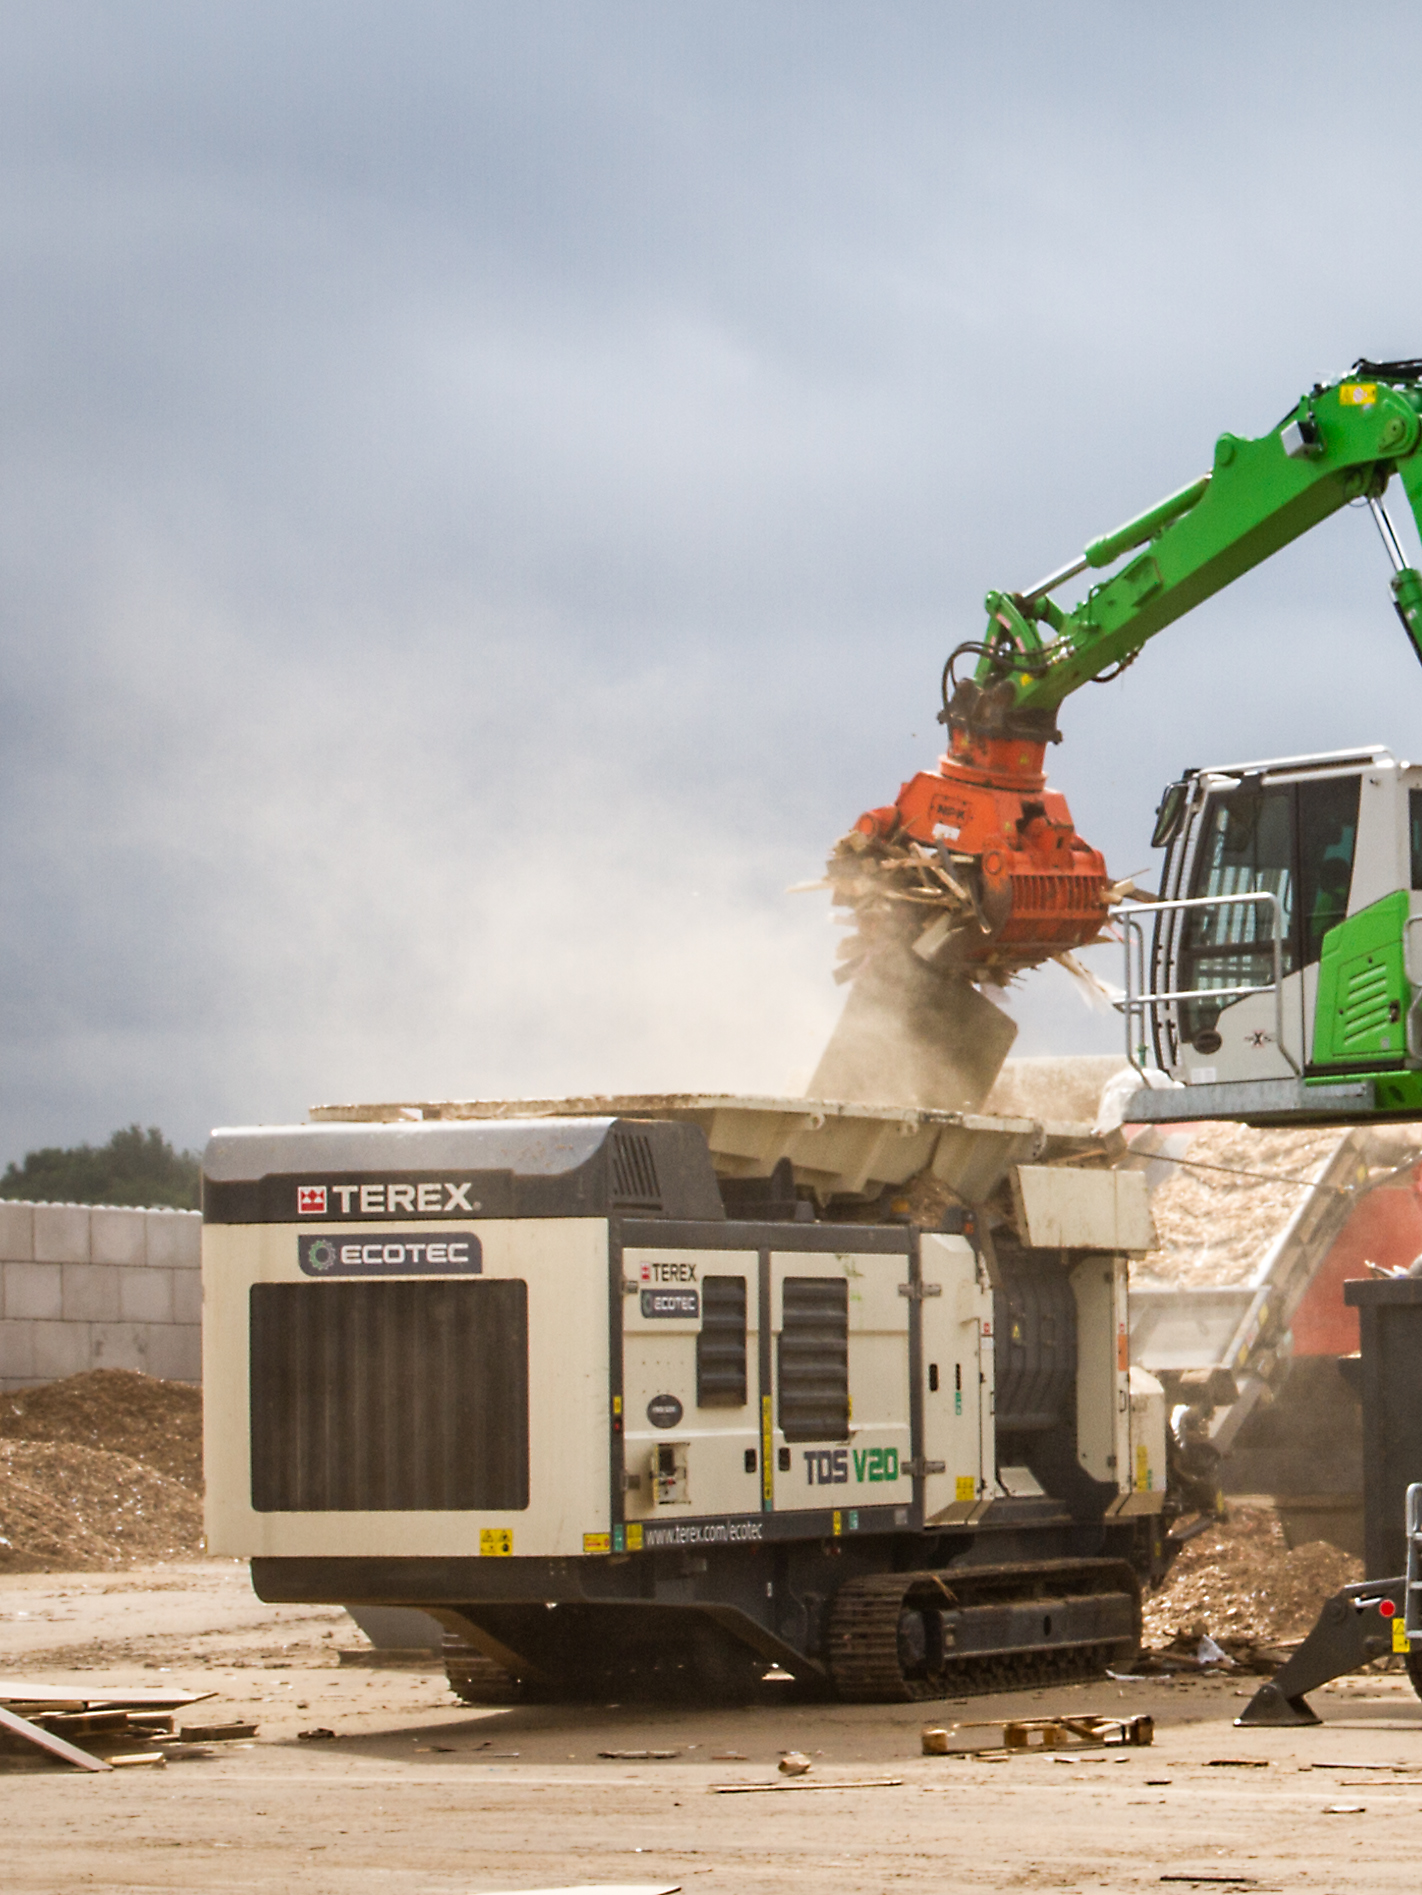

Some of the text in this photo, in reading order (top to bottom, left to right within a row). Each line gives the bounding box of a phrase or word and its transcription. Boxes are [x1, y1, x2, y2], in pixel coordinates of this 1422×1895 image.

[332, 1182, 474, 1213] TEREX
[341, 1242, 469, 1264] ECOTEC
[652, 1263, 697, 1282] TEREX
[654, 1296, 696, 1311] ECOTEC
[803, 1447, 899, 1485] TDS V20
[645, 1522, 763, 1545] www.terex.com/ecotec
